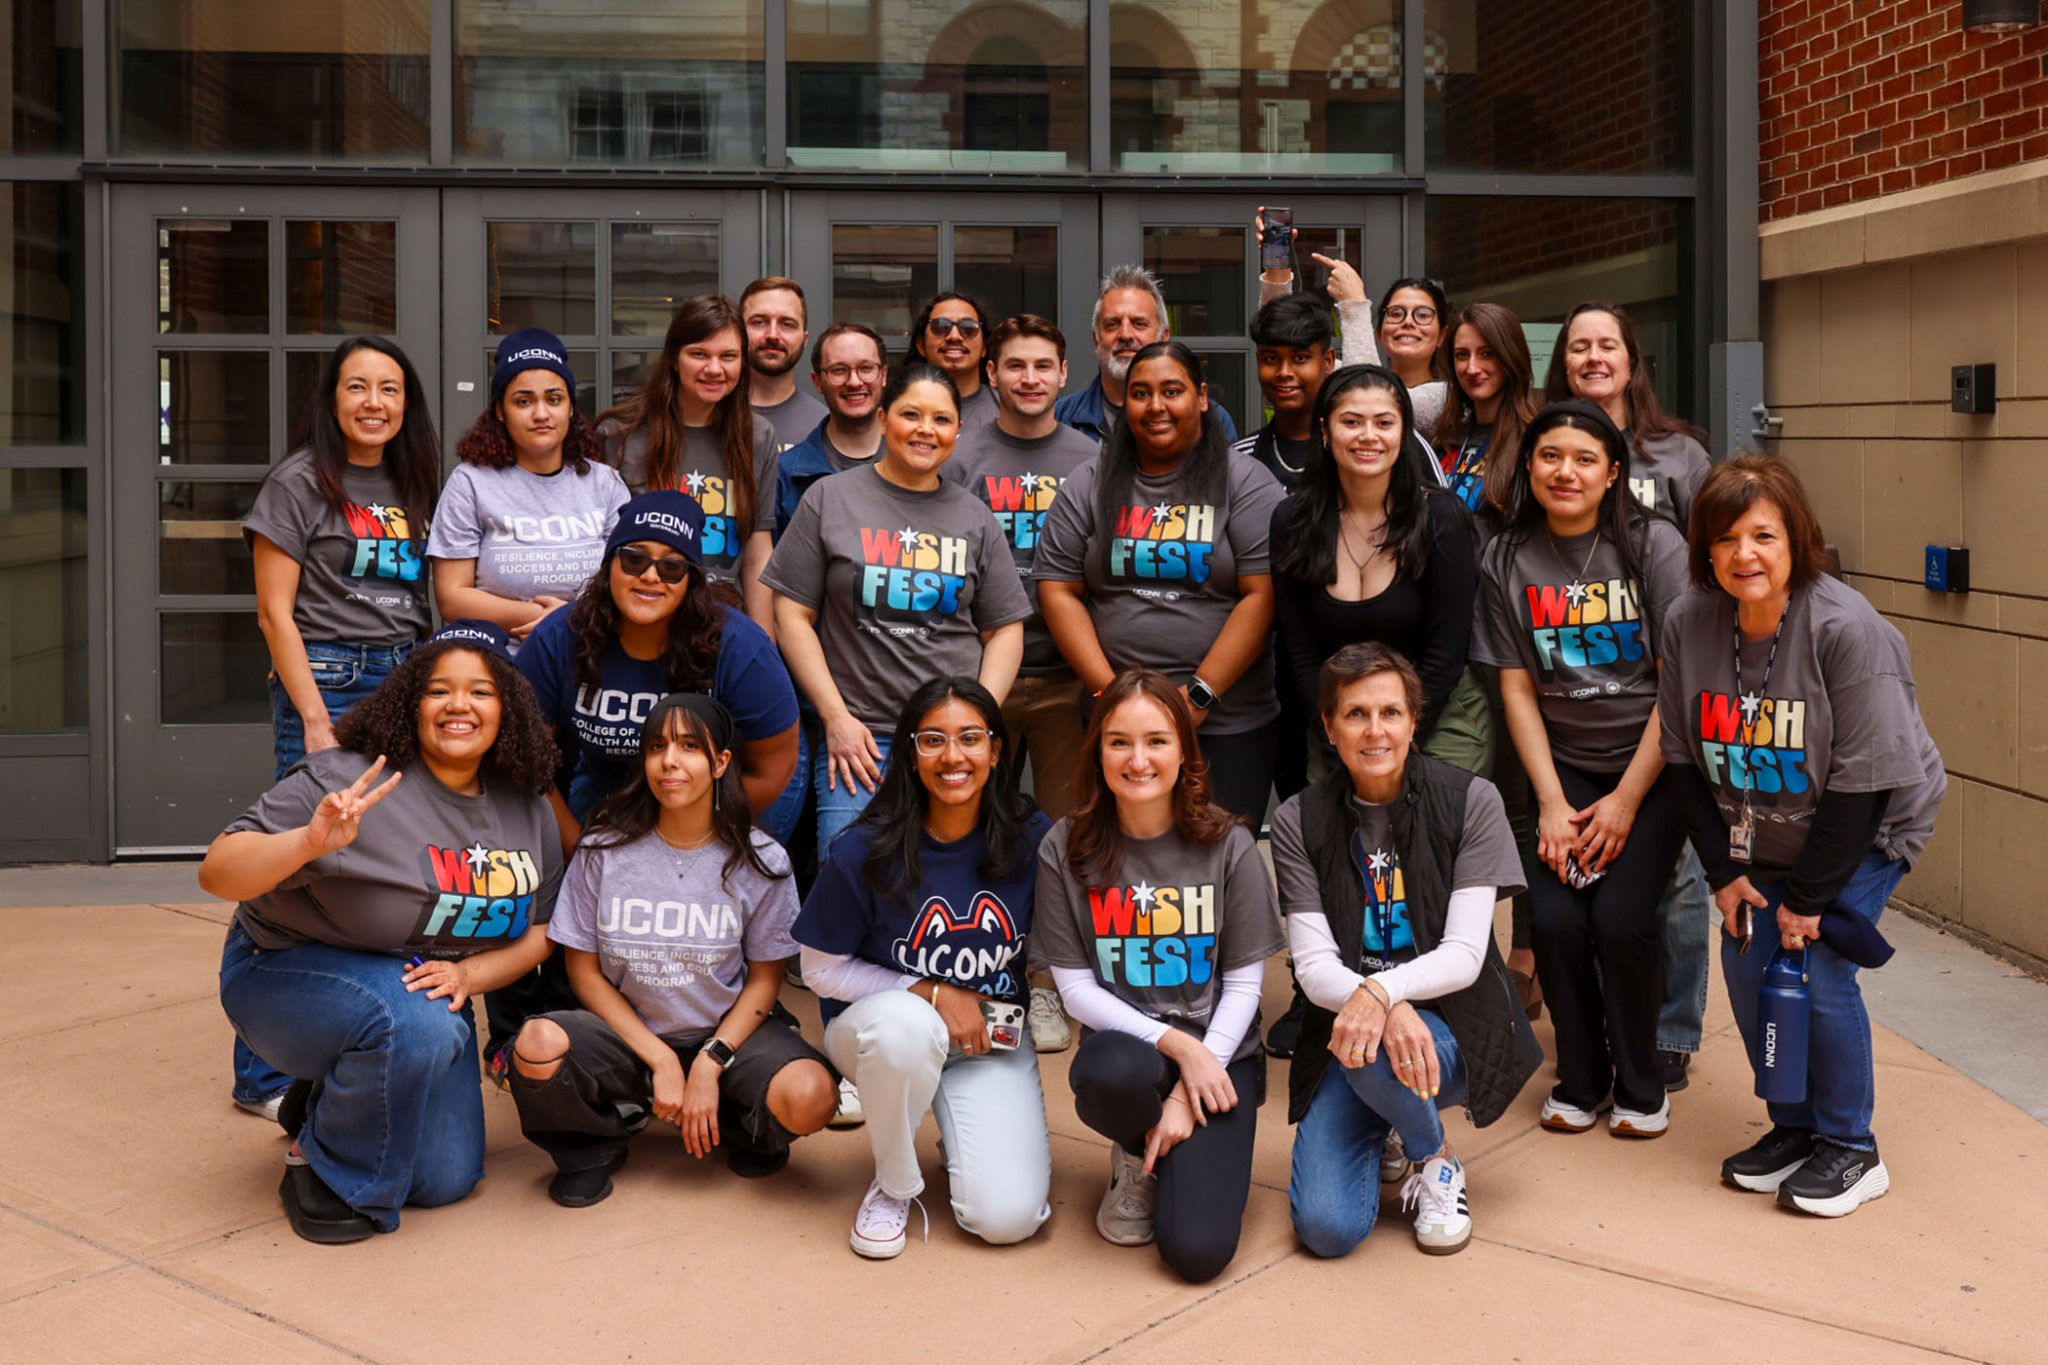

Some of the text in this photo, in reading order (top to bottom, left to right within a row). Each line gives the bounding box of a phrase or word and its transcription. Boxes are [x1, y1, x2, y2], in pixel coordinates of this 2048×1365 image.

[508, 348, 563, 364] UCONN
[635, 512, 694, 540] UCONN
[494, 551, 562, 563] RESILIENCE,
[499, 564, 553, 574] SUCCESS
[556, 561, 580, 572] AND
[1111, 538, 1214, 584] FEST
[862, 565, 965, 615] FEST
[1533, 621, 1643, 671] FEST
[1569, 686, 1600, 698] UCONN
[579, 731, 620, 746] HEALTH
[619, 728, 635, 736] OF
[1702, 741, 1809, 794] FEST
[423, 894, 533, 938] FEST
[597, 897, 743, 939] UCONN
[660, 962, 685, 974] AND
[1096, 936, 1216, 987] FEST
[636, 974, 695, 988] PROGRAM
[1765, 1022, 1776, 1068] UCONN
